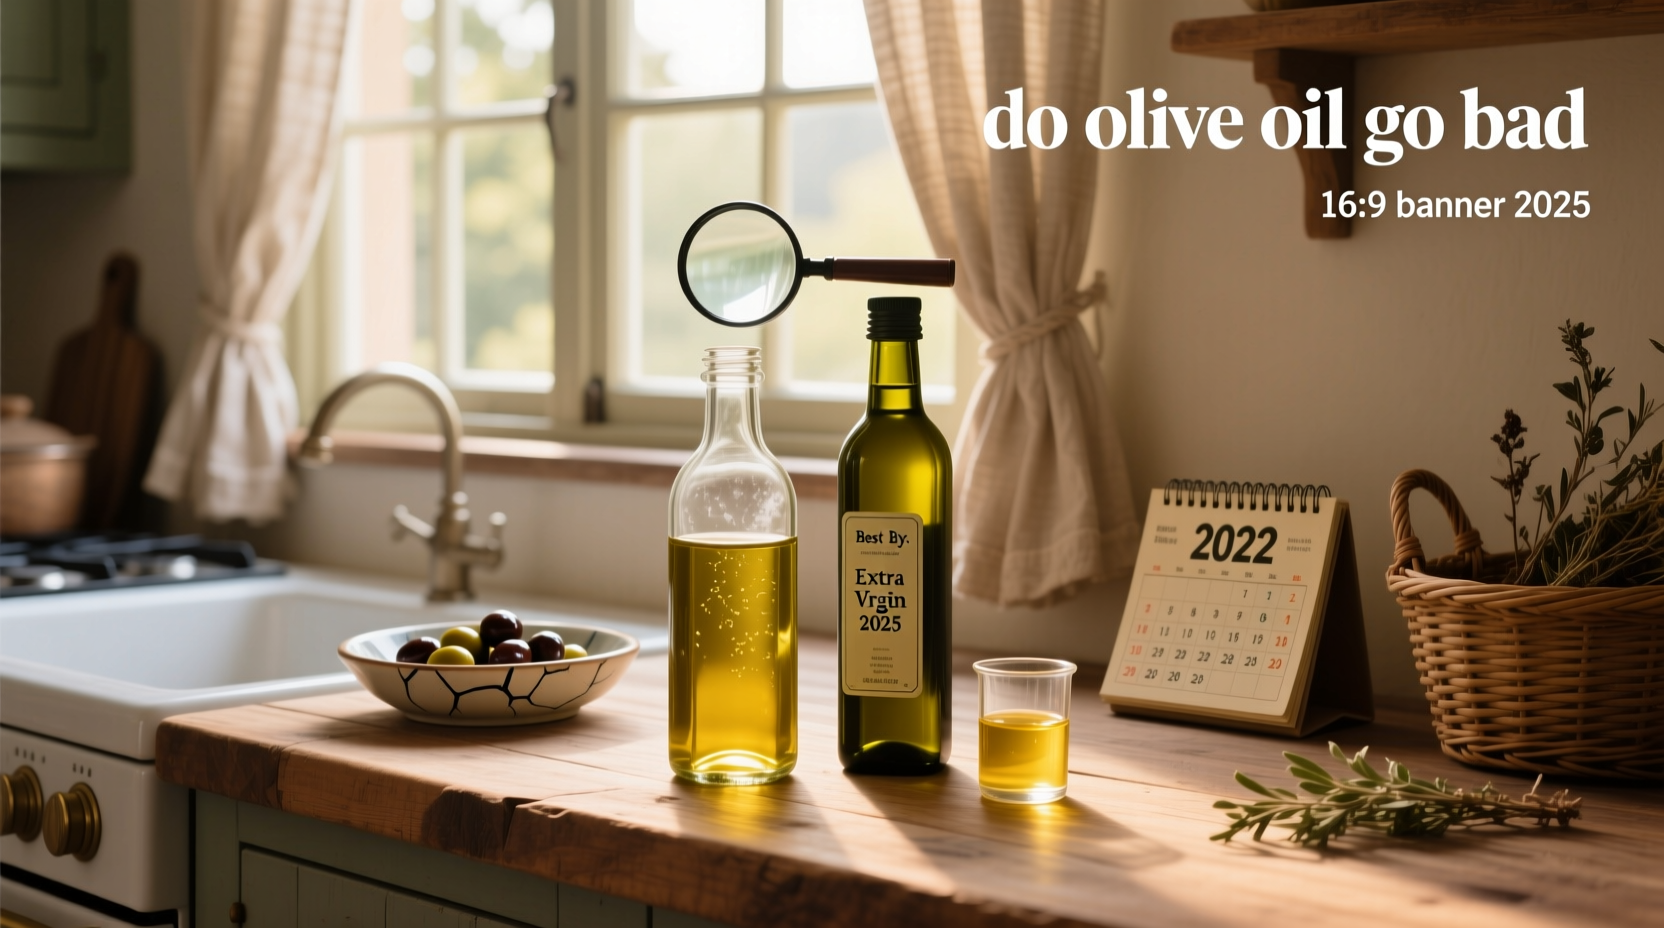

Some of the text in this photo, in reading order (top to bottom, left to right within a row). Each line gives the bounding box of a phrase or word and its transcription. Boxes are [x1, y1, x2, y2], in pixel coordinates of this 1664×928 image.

[856, 530, 909, 548] Best By.
[1190, 522, 1278, 564] 2022
[855, 569, 904, 585] Extra
[855, 590, 907, 614] Vrgin
[860, 615, 901, 632] 2025
